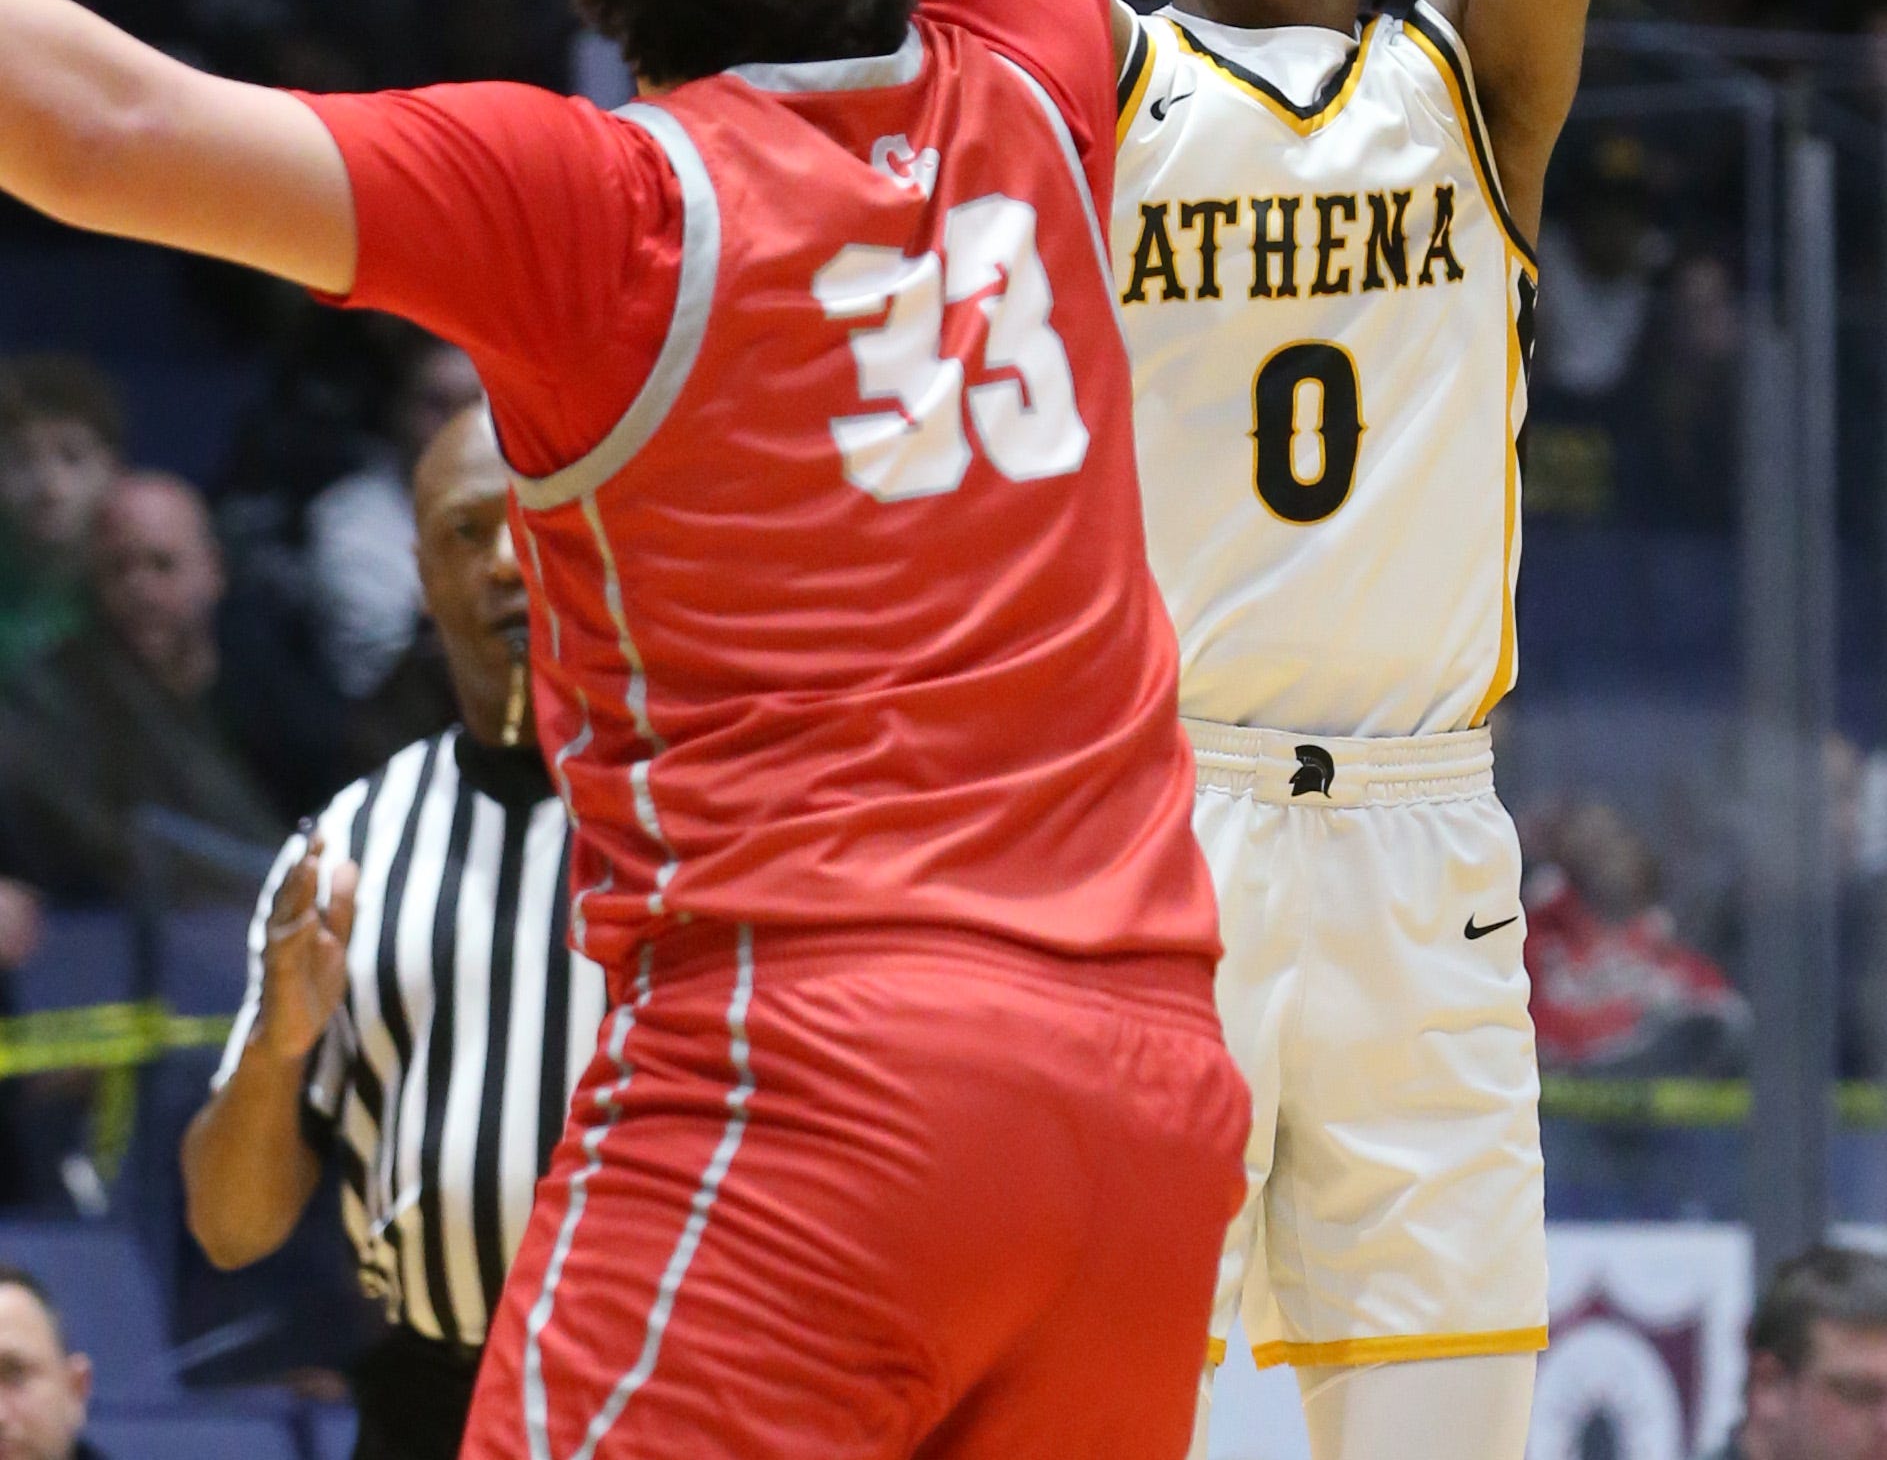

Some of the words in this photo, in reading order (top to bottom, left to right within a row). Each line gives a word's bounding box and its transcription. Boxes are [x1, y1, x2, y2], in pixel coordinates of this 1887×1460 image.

[1120, 180, 1466, 305] ATHENA
[811, 192, 1090, 503] 33
[1246, 338, 1369, 527] 0
